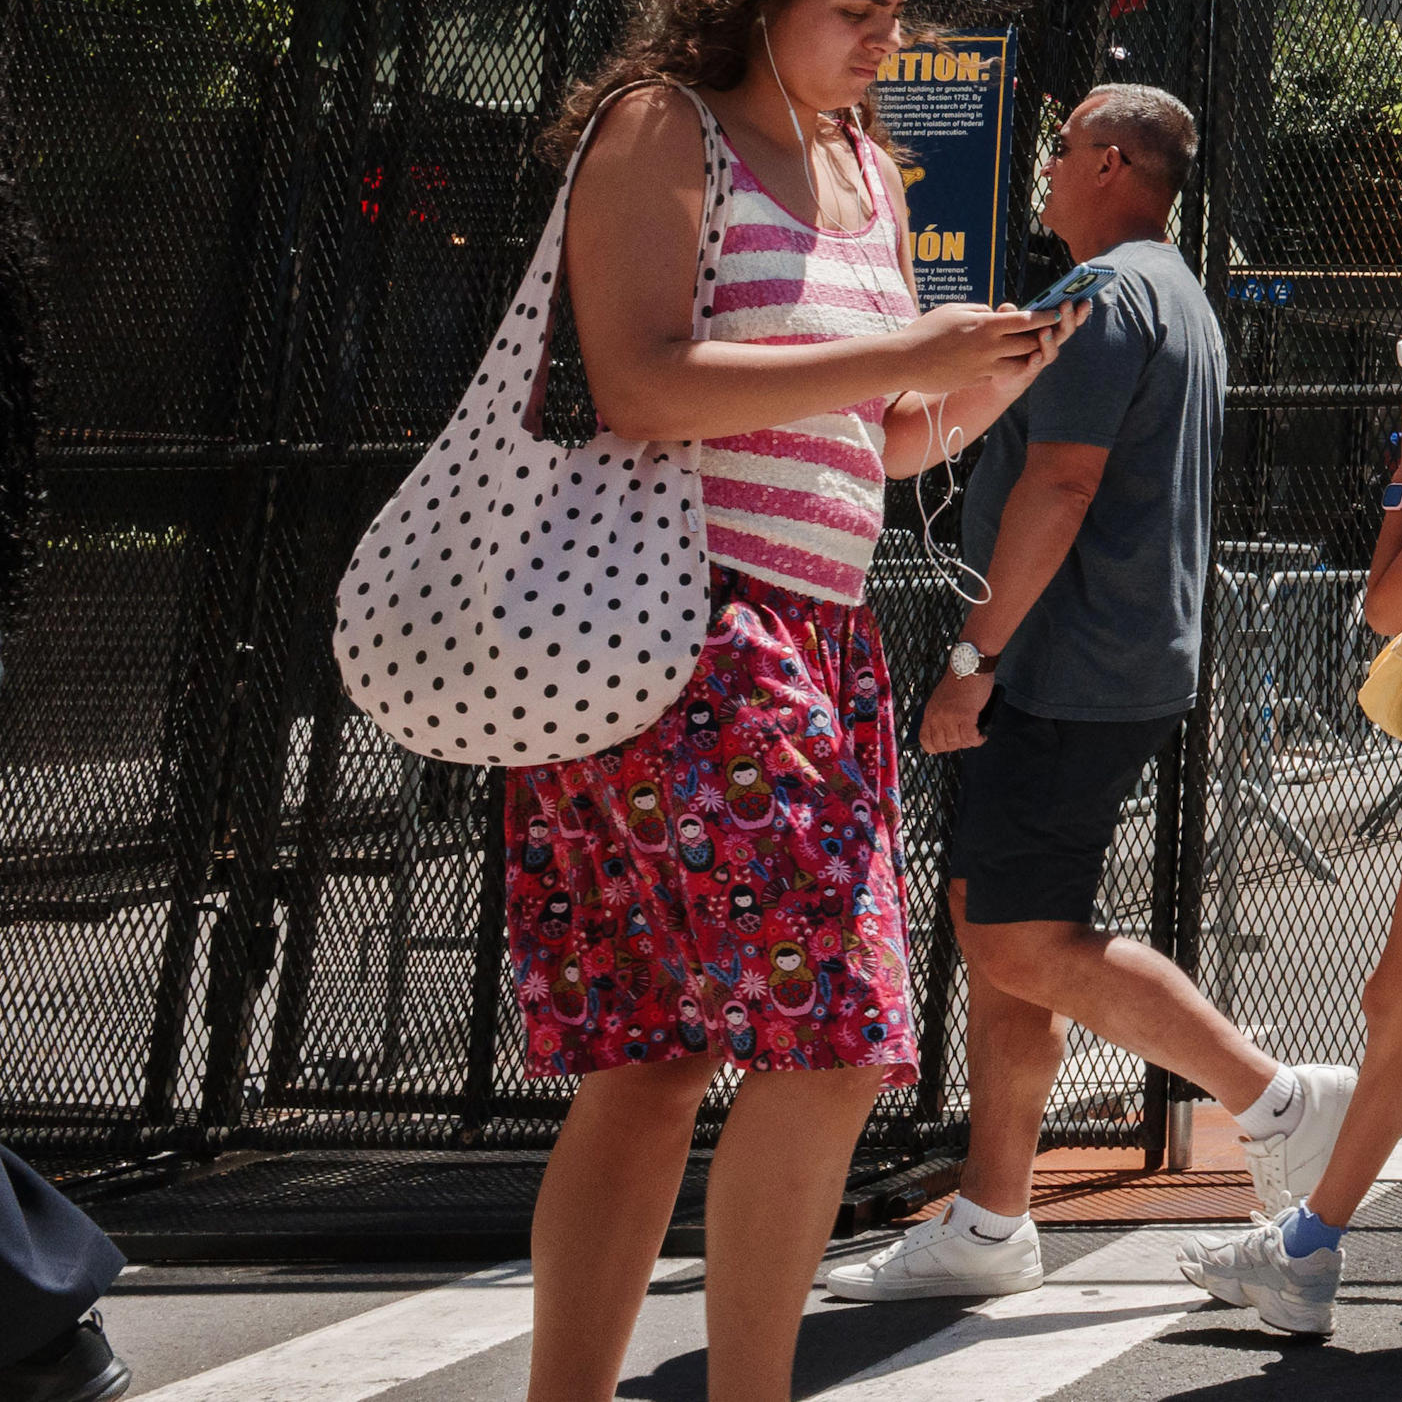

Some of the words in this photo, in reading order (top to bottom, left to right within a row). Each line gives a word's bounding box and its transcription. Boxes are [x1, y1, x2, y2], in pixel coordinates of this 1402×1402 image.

[907, 86, 935, 94] building
[972, 94, 982, 102] By
[904, 112, 931, 120] entering
[952, 120, 960, 128] of
[960, 120, 984, 128] federal
